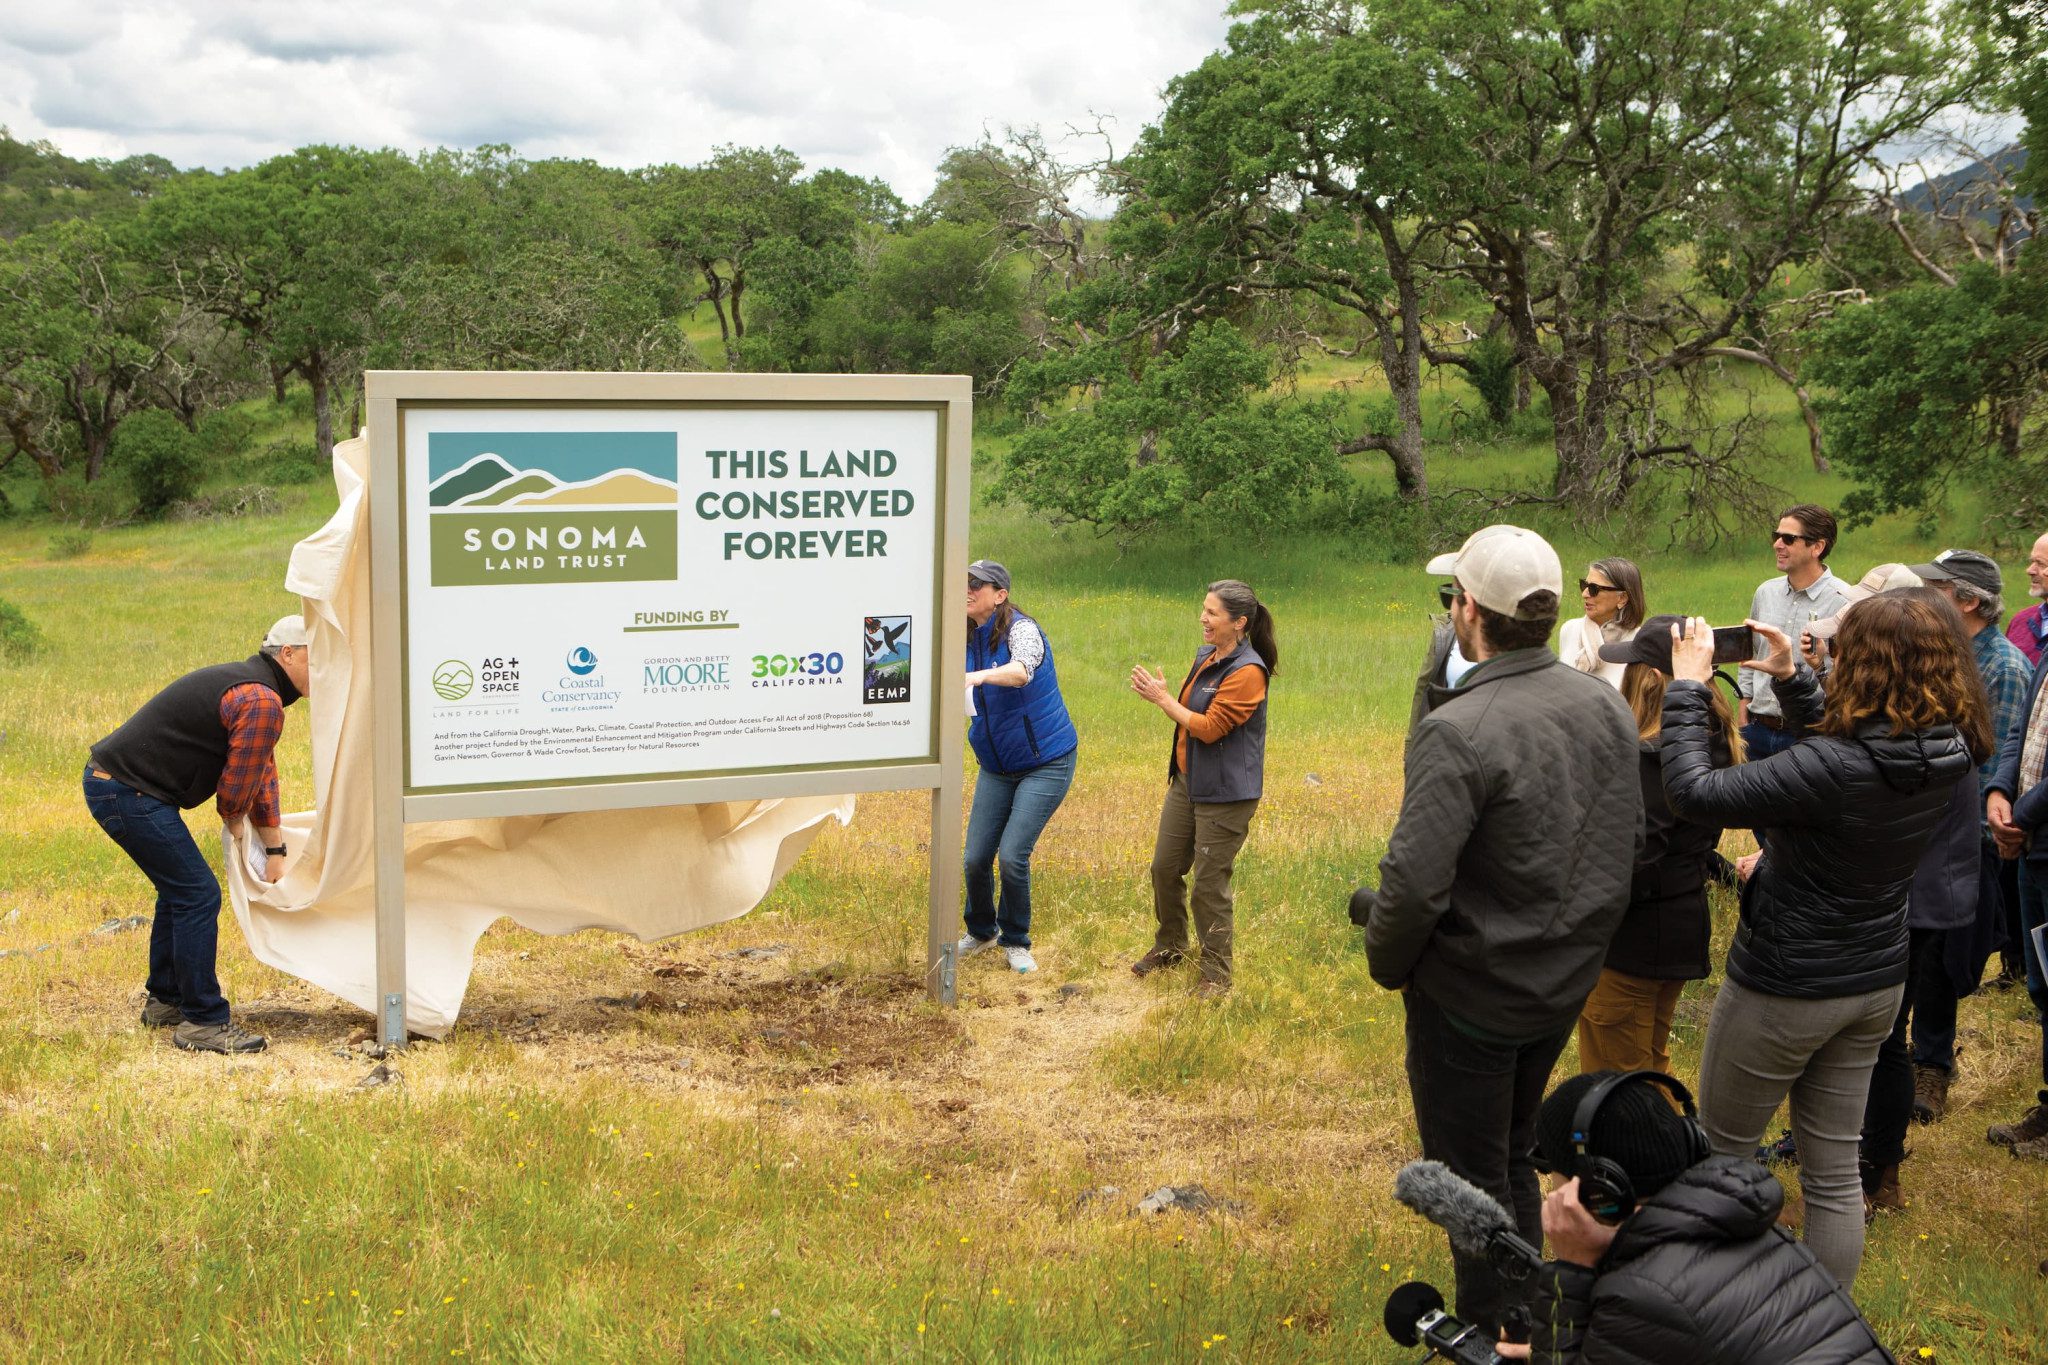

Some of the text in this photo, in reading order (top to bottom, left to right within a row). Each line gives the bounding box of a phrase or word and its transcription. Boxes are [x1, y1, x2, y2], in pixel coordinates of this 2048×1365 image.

[705, 450, 897, 479] THIS LAND
[695, 489, 915, 520] CONSERVED
[463, 525, 647, 552] SONOMA
[724, 529, 888, 560] FOREVER
[485, 554, 627, 570] LAND TRUST
[634, 609, 729, 624] FUNDING BY
[482, 657, 504, 669] AG
[643, 657, 681, 665] GORDON
[482, 671, 520, 682] OPEN
[559, 674, 605, 689] Coastal
[643, 662, 730, 686] MOORE
[482, 682, 520, 693] SPACE
[643, 684, 730, 694] FOUNDATION
[752, 676, 843, 688] CALIFORNIA
[541, 690, 622, 704] Conservancy
[868, 687, 907, 700] EEMP
[432, 711, 462, 719] LAND
[450, 731, 468, 739] from
[483, 729, 518, 738] California
[519, 727, 551, 737] Drought,
[552, 726, 574, 734] Water,
[576, 725, 597, 733] Parks,
[598, 724, 627, 732] Climate,
[628, 722, 655, 730] Coastal
[708, 717, 737, 726] Outdoor
[823, 712, 862, 721] (Proposition
[434, 743, 464, 751] Another
[465, 741, 491, 750] project
[493, 739, 518, 748] funded
[519, 738, 529, 747] by
[543, 736, 594, 745] Environmental
[595, 734, 642, 743] Enhancement
[643, 732, 656, 740] and
[657, 730, 692, 740] Mitigation
[693, 729, 722, 738] Program
[723, 727, 742, 735] under
[744, 726, 777, 735] California
[802, 723, 815, 731] and
[816, 722, 847, 732] Highways
[847, 721, 865, 729] Code
[866, 719, 890, 728] Section
[434, 740, 700, 761] Gavin Newsom, Governor & Wade Crowfoot, Secretary for Natural Resources
